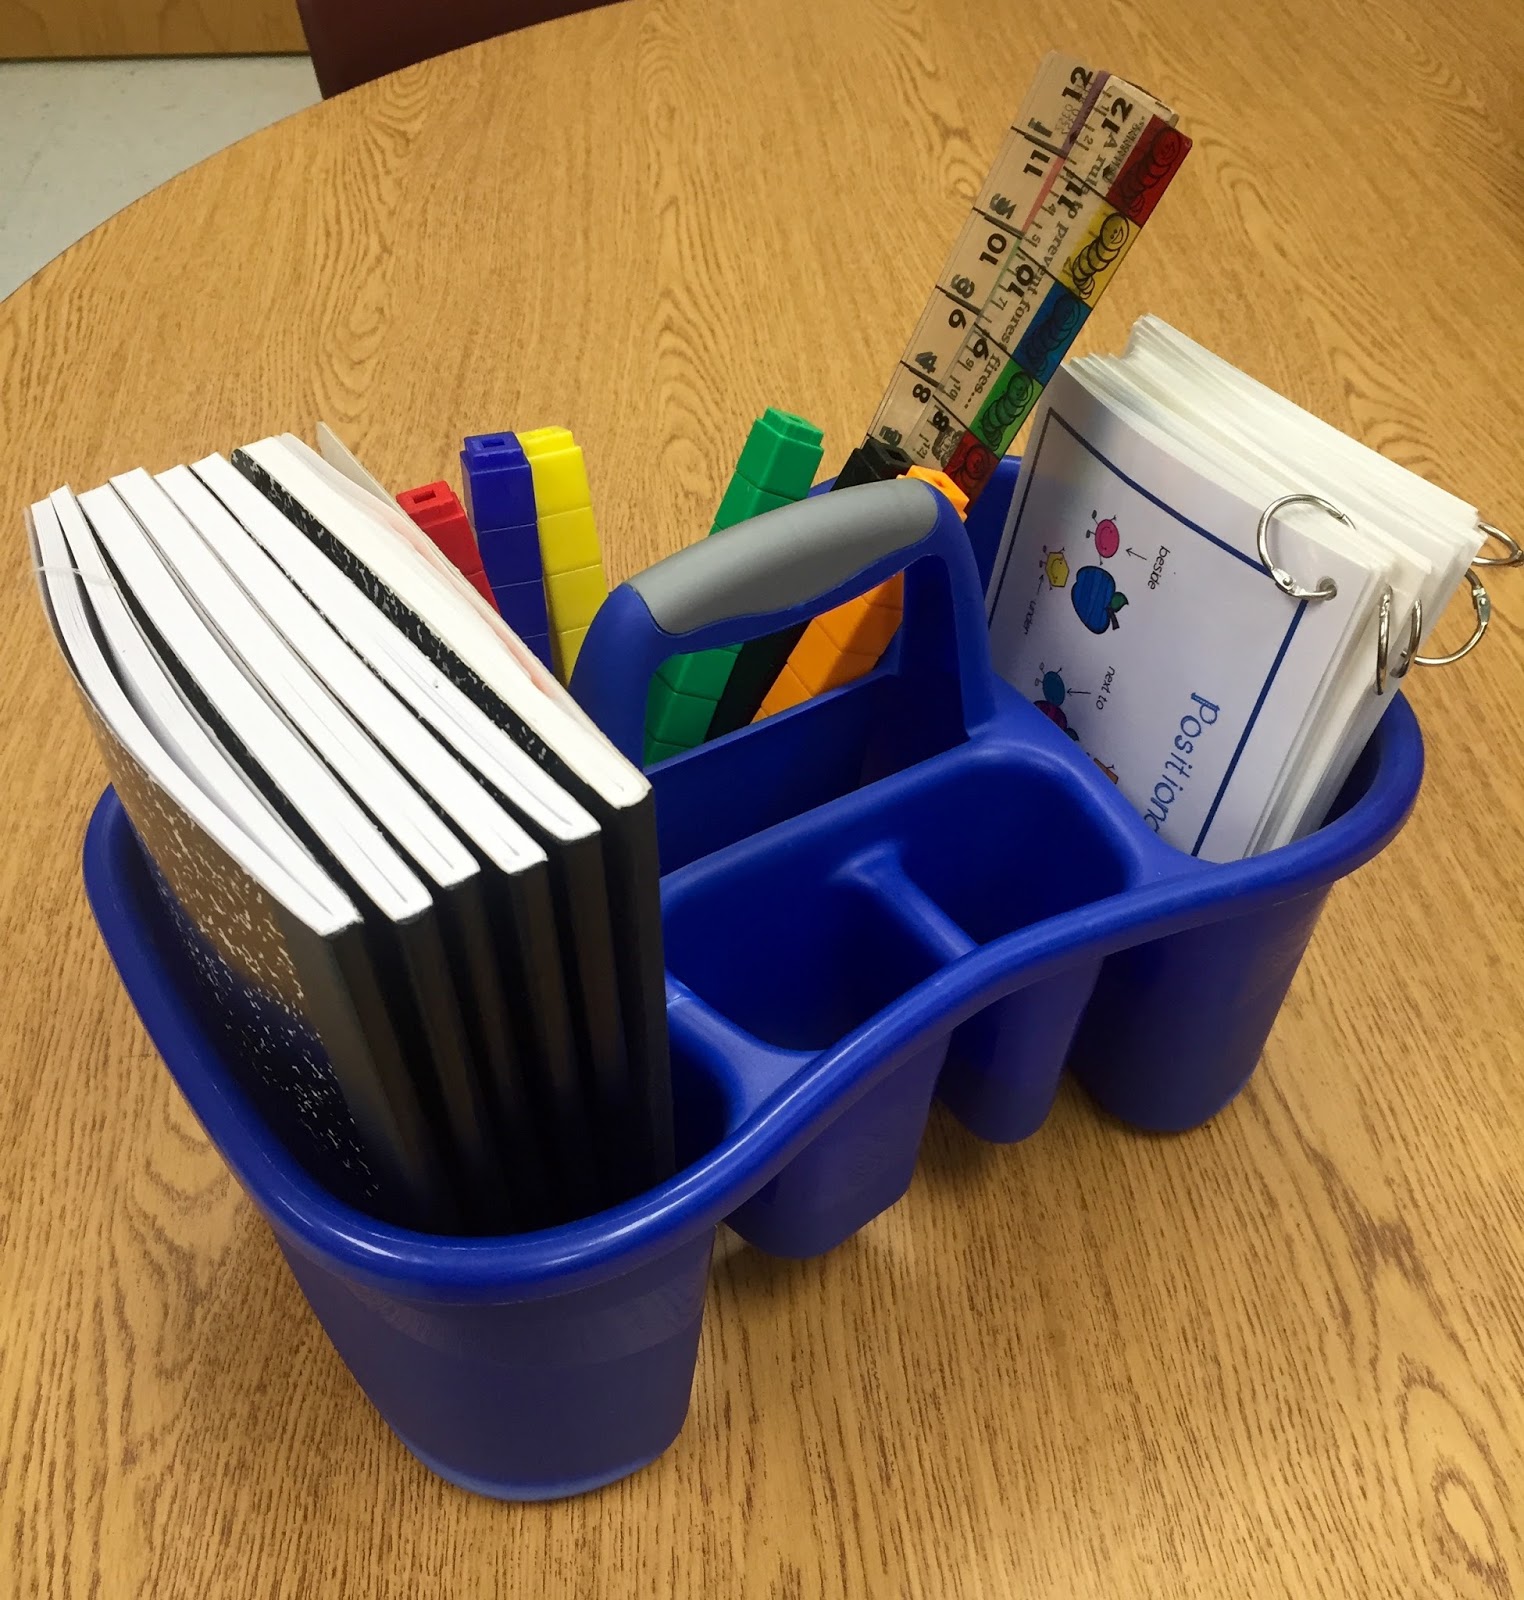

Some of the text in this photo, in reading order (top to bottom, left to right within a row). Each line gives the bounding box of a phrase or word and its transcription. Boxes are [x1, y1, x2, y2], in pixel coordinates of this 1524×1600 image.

[1061, 66, 1094, 101] 12
[1101, 97, 1134, 134] 12
[1103, 132, 1118, 149] A
[1022, 149, 1051, 178] 11
[1057, 179, 1085, 212] 11
[979, 233, 1008, 266] 10
[1006, 263, 1035, 298] 10
[911, 382, 932, 404] 8
[931, 410, 951, 432] 8
[1147, 545, 1171, 591] beside
[1022, 600, 1039, 636] under
[1095, 665, 1116, 710] next to
